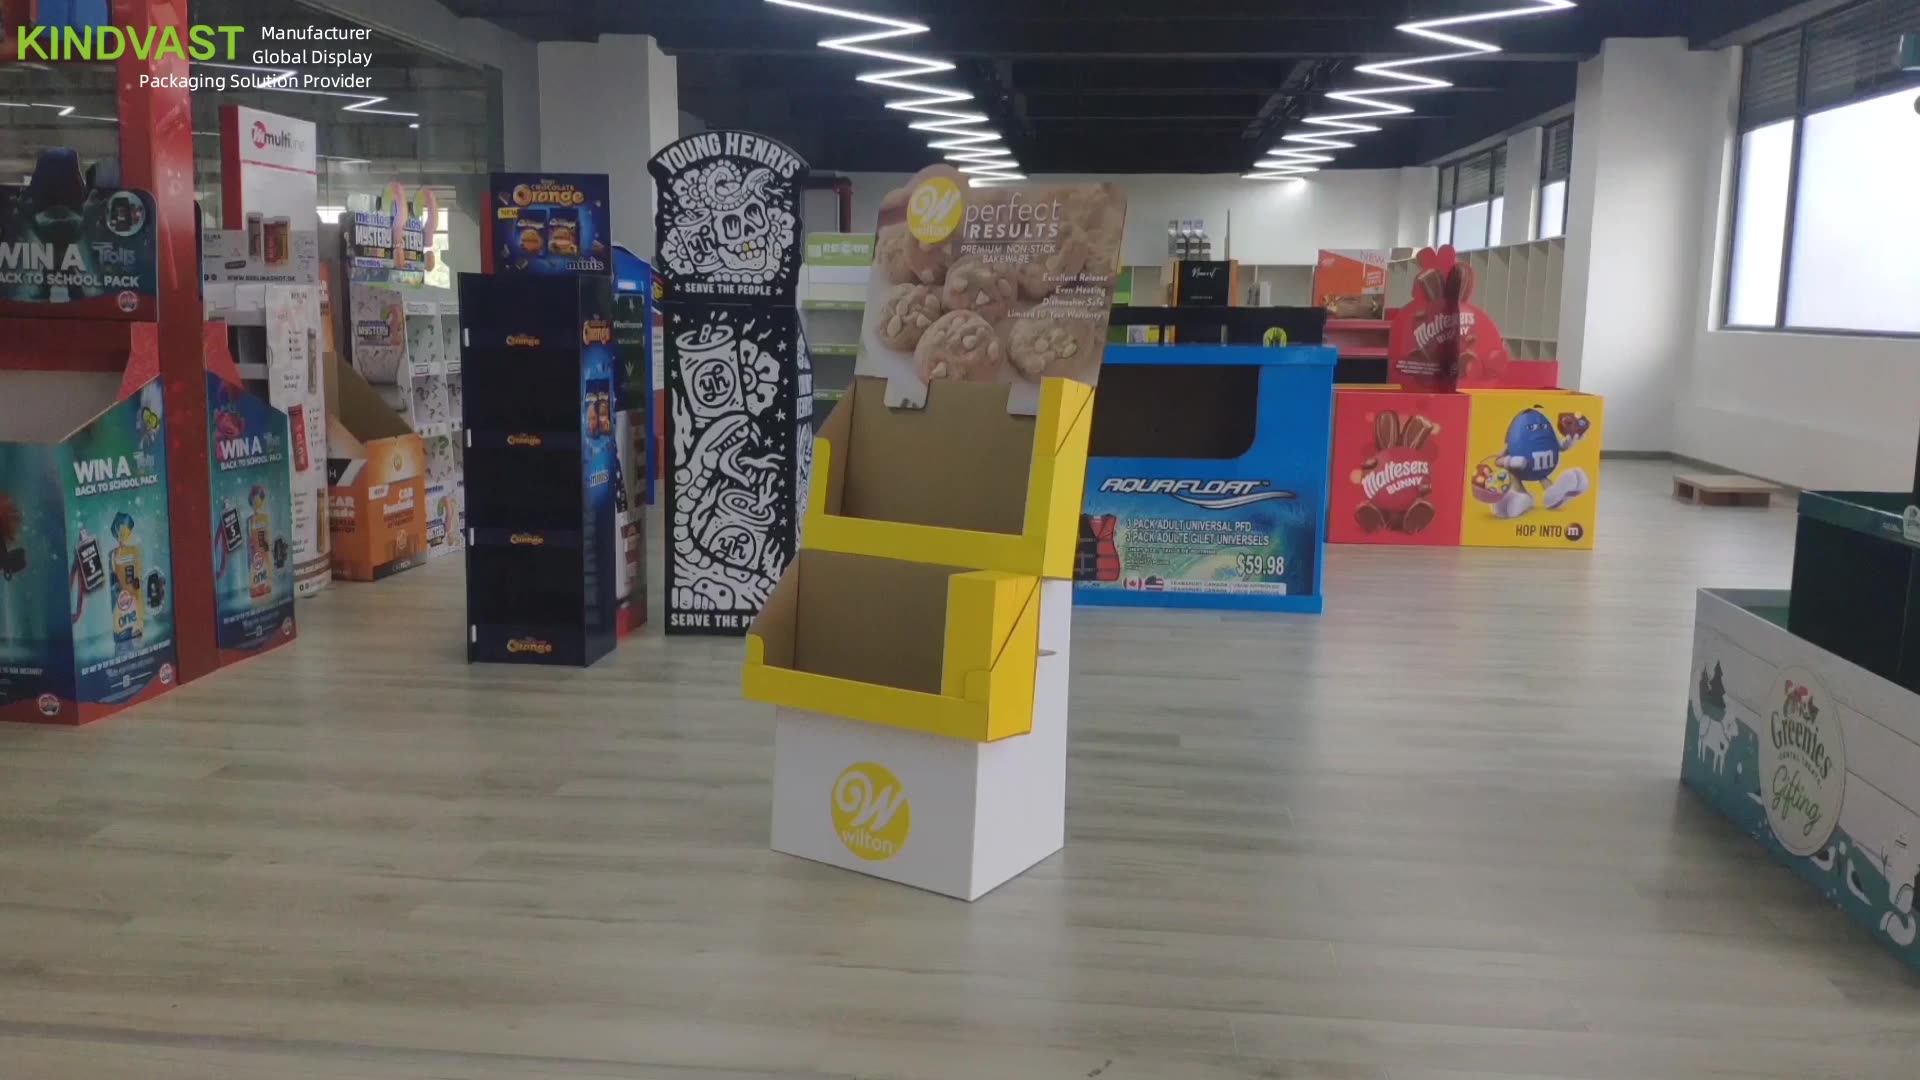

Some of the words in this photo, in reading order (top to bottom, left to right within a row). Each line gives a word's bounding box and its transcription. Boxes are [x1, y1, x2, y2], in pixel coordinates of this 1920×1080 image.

[656, 132, 722, 175] YOUNG
[725, 132, 801, 179] HENRYS
[512, 184, 584, 207] Orange
[965, 192, 1062, 238] perfect
[356, 225, 392, 248] MYSTERY
[970, 223, 1060, 240] RESULTS
[61, 243, 87, 271] A
[961, 244, 1000, 254] PREMIUM
[982, 254, 1031, 264] BAKEWARE
[0, 273, 24, 284] ACK
[27, 273, 44, 285] TO
[47, 273, 101, 286] SCHOOL
[104, 274, 139, 288] PACK
[1079, 273, 1109, 282] Release
[684, 282, 714, 294] SERVE
[717, 283, 735, 294] THE
[738, 284, 772, 297] PEOPLE
[1055, 285, 1074, 294] Even
[1075, 286, 1106, 297] Heating
[220, 437, 250, 460] WIN
[251, 435, 262, 455] A
[73, 457, 114, 485] WIN
[116, 455, 132, 478] A
[75, 484, 97, 497] BACK
[98, 482, 109, 492] TO
[110, 478, 140, 491] SCHOOL
[140, 474, 158, 486] PACK
[1099, 477, 1261, 495] AQUAFLOAT
[1361, 461, 1429, 499] Maltesers
[1386, 476, 1423, 495] BUNNY
[1133, 519, 1155, 530] PACK
[1157, 519, 1184, 530] ADULT
[1185, 520, 1232, 531] UNIVERSAL
[1515, 524, 1536, 537] HOP
[1539, 524, 1562, 538] INTO
[1132, 531, 1155, 542] PACK
[1156, 532, 1189, 543] ADULTE
[1191, 533, 1214, 544] GILET
[1216, 534, 1270, 546] UNIVERSELS
[1236, 554, 1285, 576] $59.98
[119, 610, 137, 628] one
[670, 613, 711, 627] SERVE
[714, 614, 739, 627] THE
[1770, 711, 1833, 780] Greenies
[1771, 765, 1823, 837] Gifting
[842, 827, 894, 854] wilton
